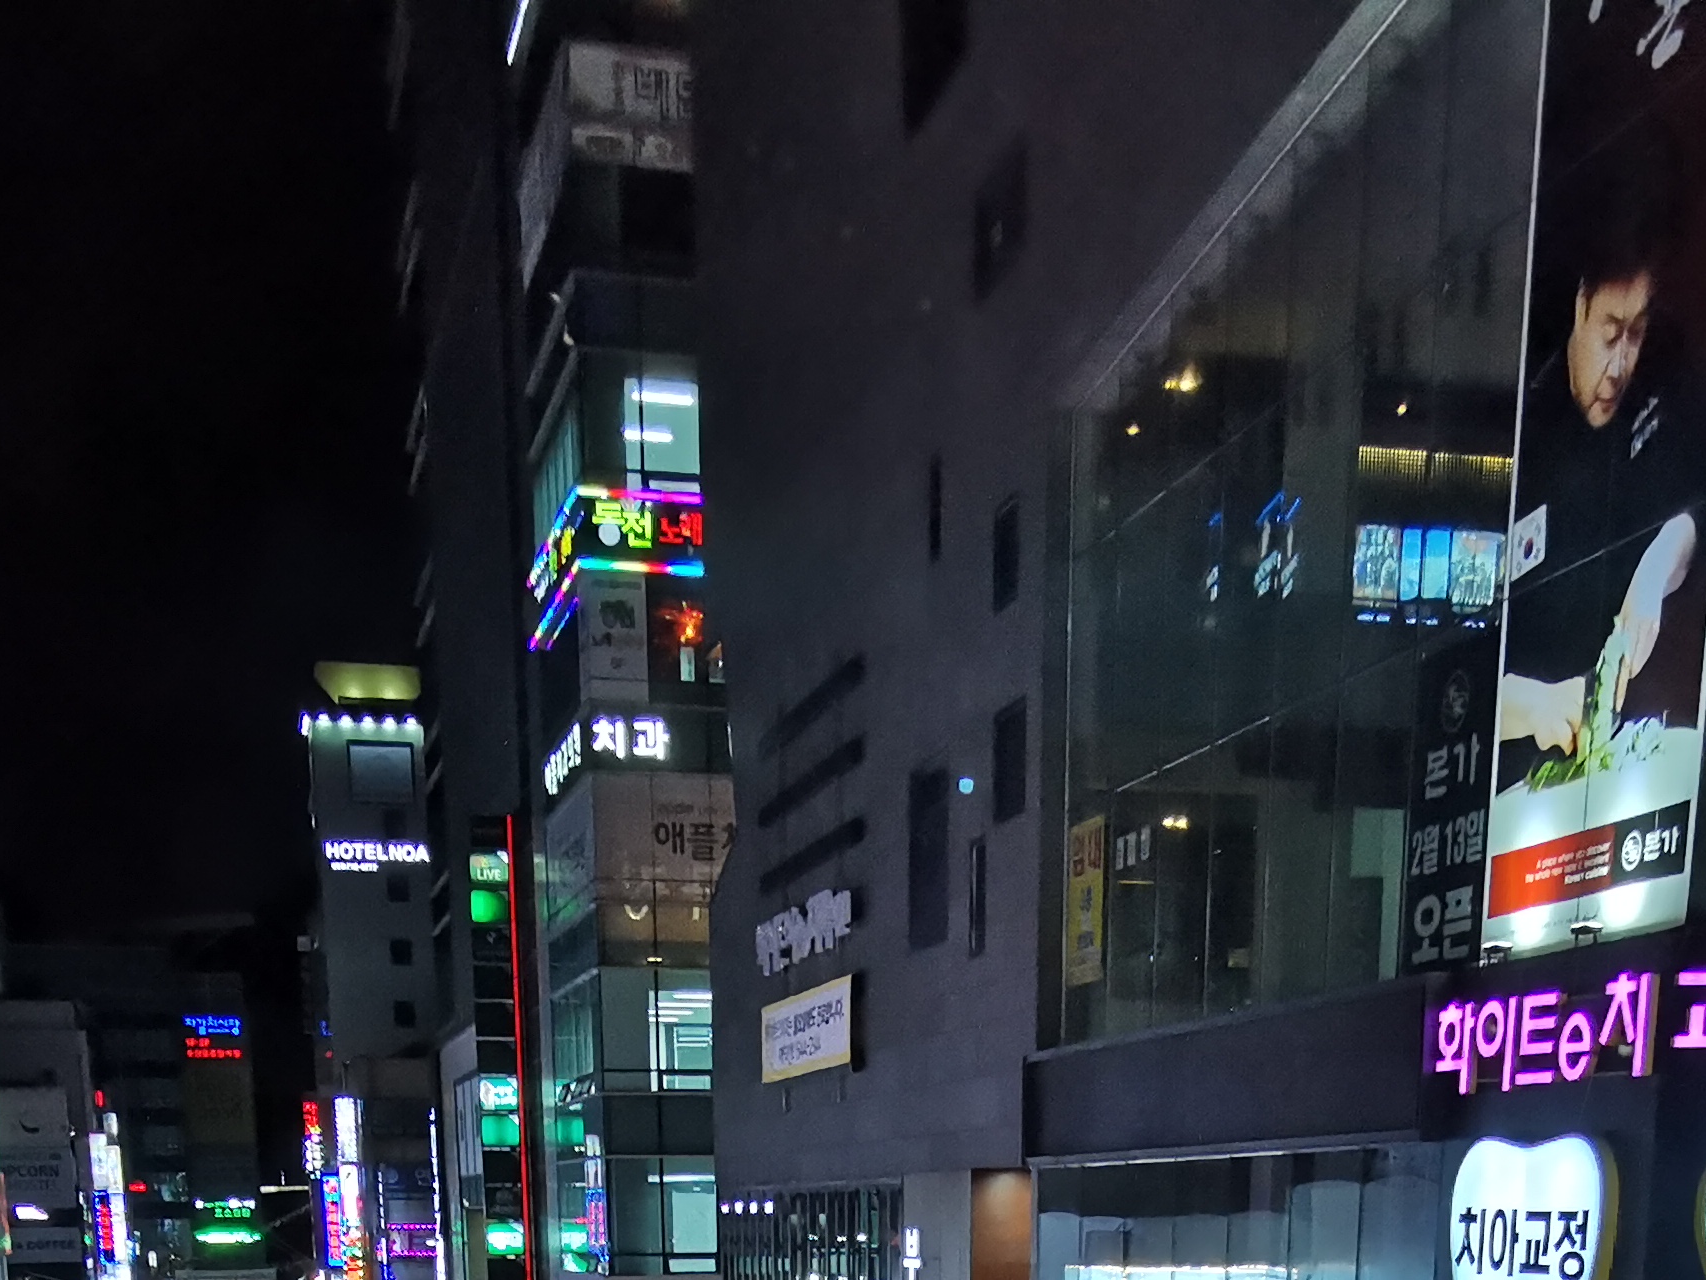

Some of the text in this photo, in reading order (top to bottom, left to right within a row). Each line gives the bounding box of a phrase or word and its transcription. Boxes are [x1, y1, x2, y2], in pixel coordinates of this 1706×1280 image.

[592, 716, 669, 760] 치과
[1426, 734, 1479, 798] 본가
[1410, 809, 1485, 877] 2월 13일
[1412, 886, 1474, 961] 오픈
